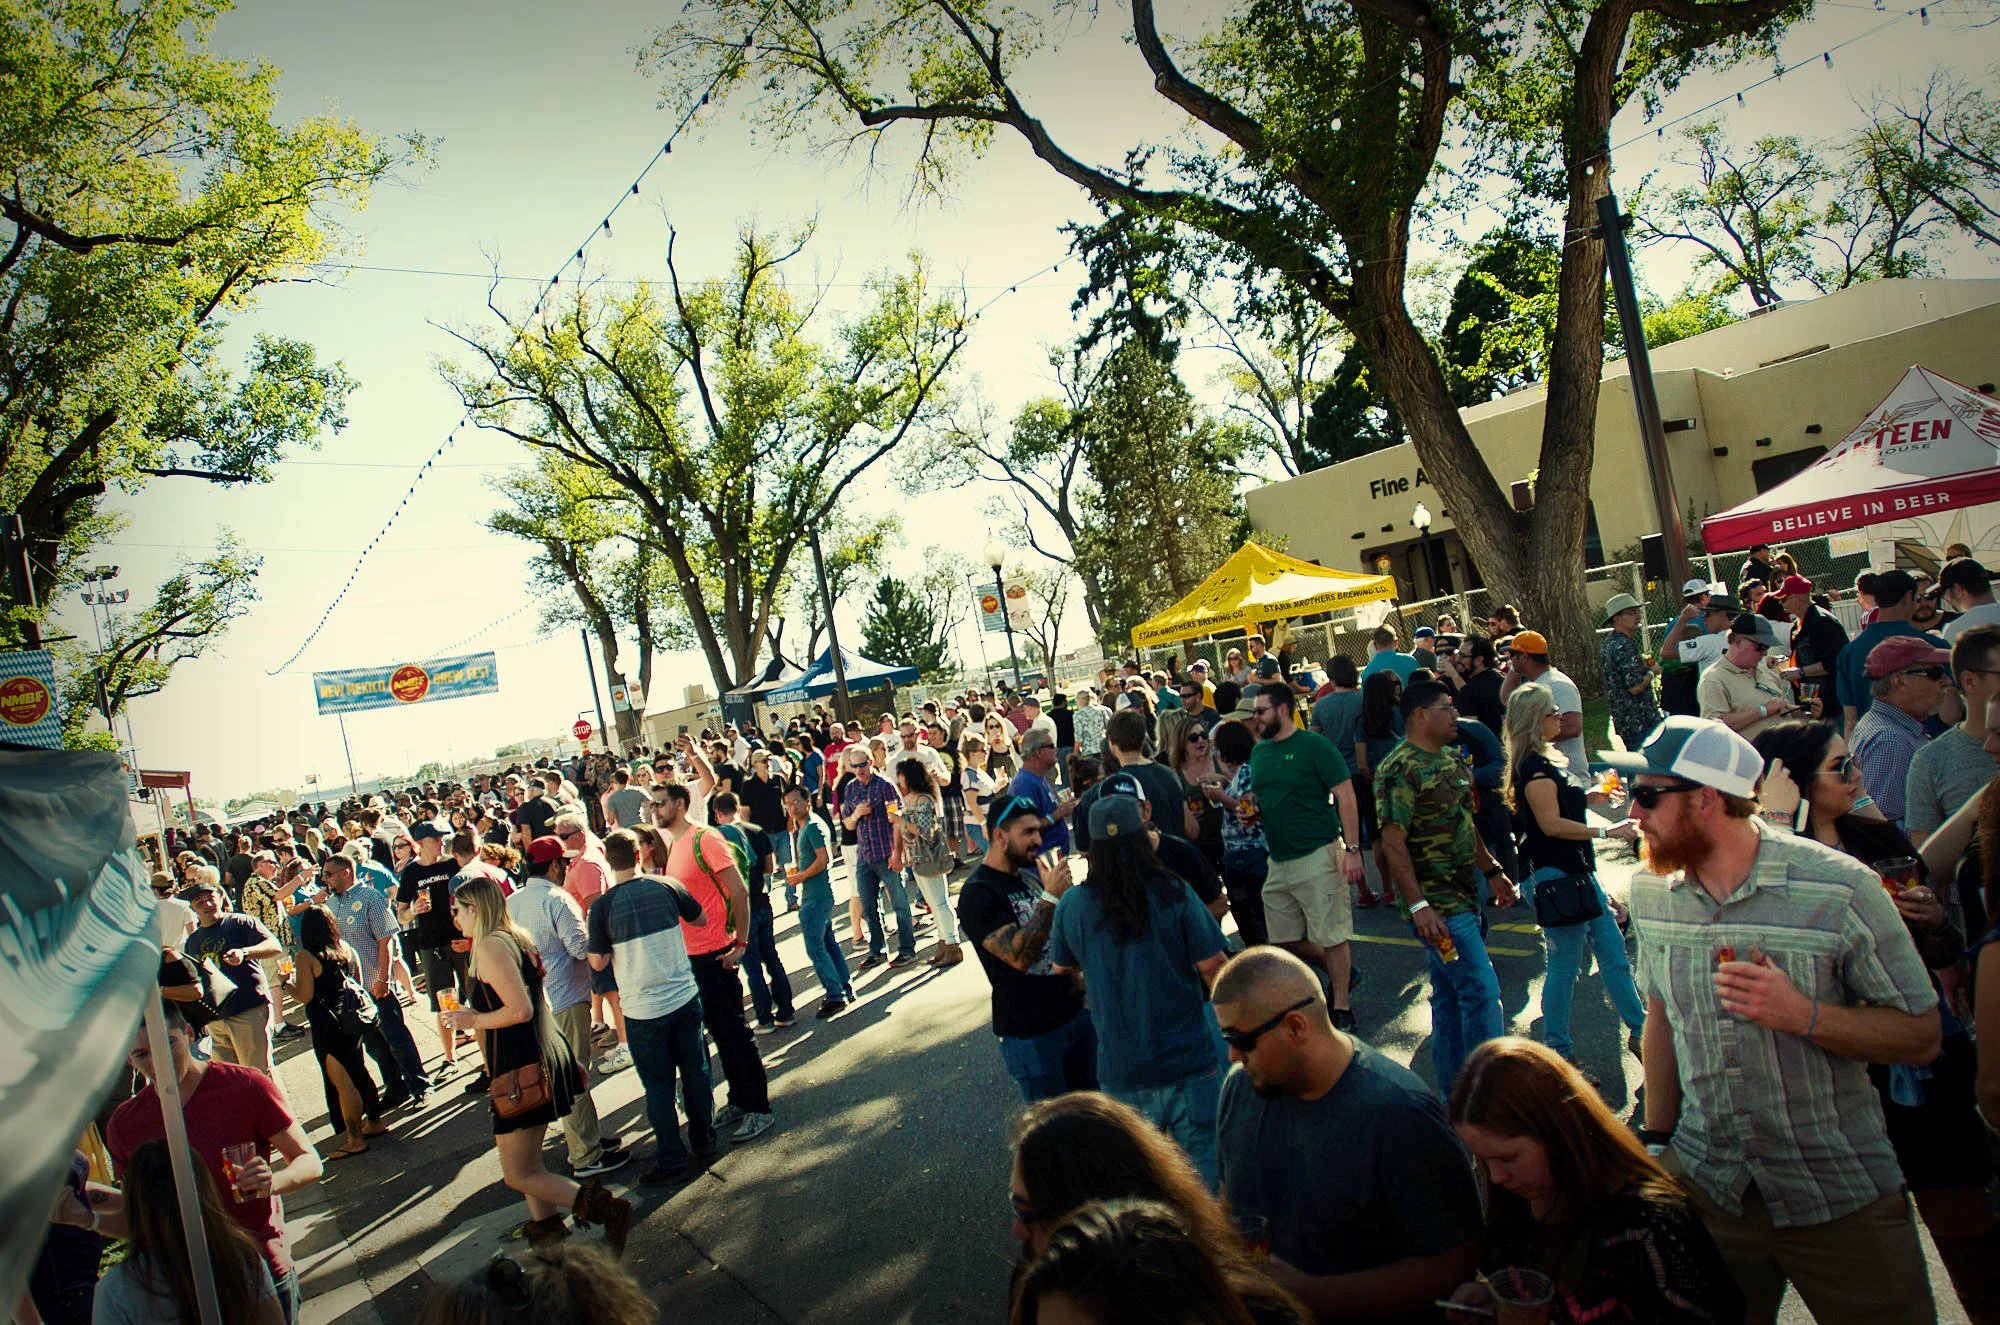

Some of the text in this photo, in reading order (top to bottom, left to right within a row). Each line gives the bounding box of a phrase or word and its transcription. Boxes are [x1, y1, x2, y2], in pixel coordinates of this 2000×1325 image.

[1370, 477, 1409, 500] Fine
[1772, 492, 1950, 533] BELIEVE IN BEER
[1263, 604, 1292, 613] STARR
[1293, 593, 1336, 609] BROTHERS
[1337, 588, 1374, 600] BREWING
[1160, 621, 1196, 636] BROTHERS
[1197, 613, 1232, 627] BREWING
[319, 685, 345, 699] NEW
[345, 680, 386, 695] MEXICO
[433, 671, 464, 684] BREW
[466, 665, 491, 681] FEST
[1, 690, 45, 708] NMBF
[573, 724, 591, 736] STOP
[417, 874, 450, 888] ROADKILL
